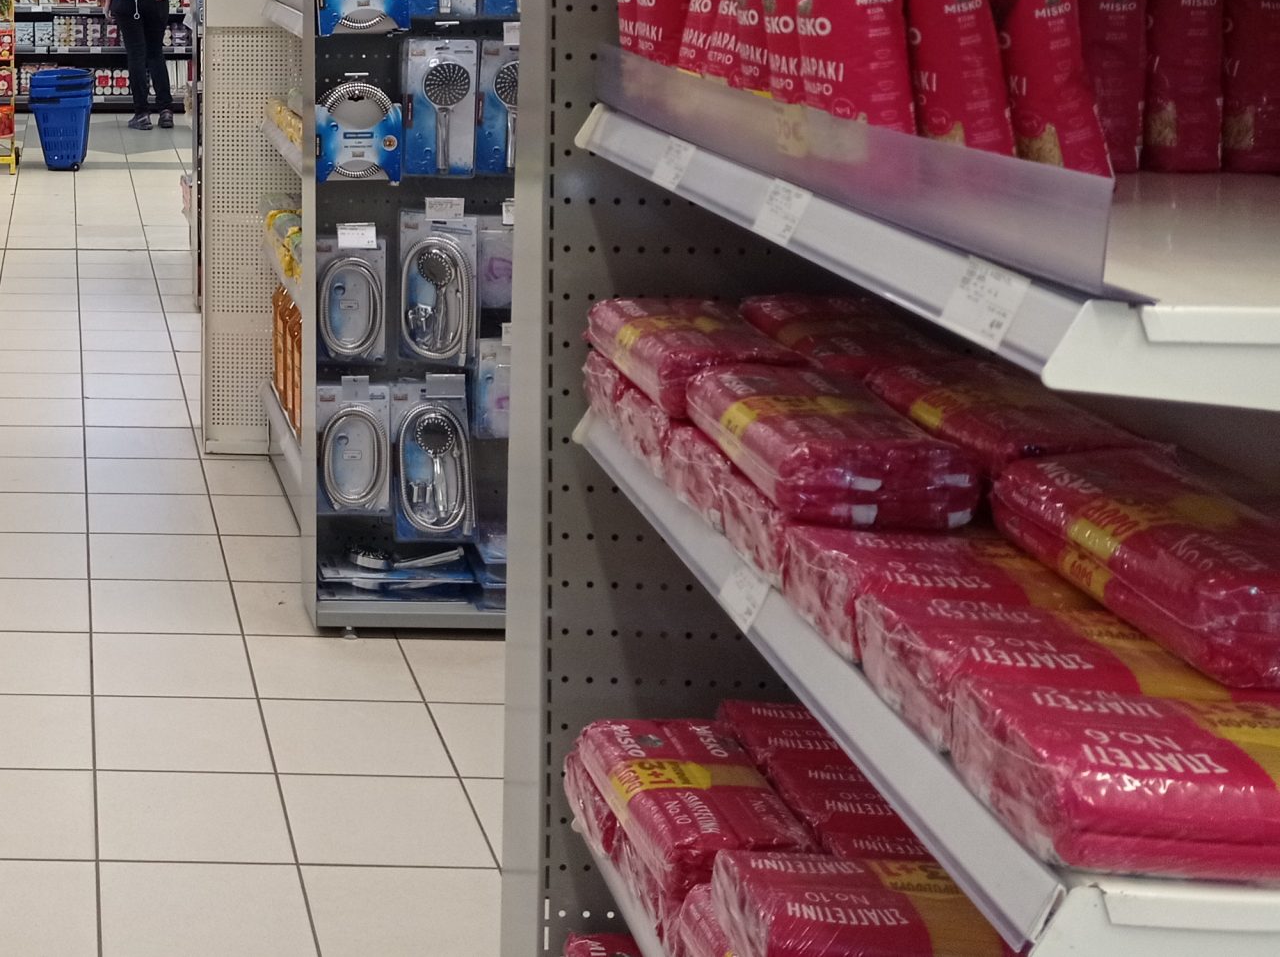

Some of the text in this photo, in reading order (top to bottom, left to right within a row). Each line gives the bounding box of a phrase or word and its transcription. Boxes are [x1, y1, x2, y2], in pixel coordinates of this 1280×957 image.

[944, 0, 982, 14] MISKO
[1035, 3, 1071, 18] MISKO
[1099, 2, 1137, 11] MISKO
[970, 647, 1095, 670] ΣΠΑΓΓΕΤΙ
[1081, 743, 1229, 774] ΣΠΑΓΓΕΤΙ
[805, 892, 870, 905] No.10
[787, 901, 909, 926] ΣΠΑΓΓΕΤΙΝΗ
